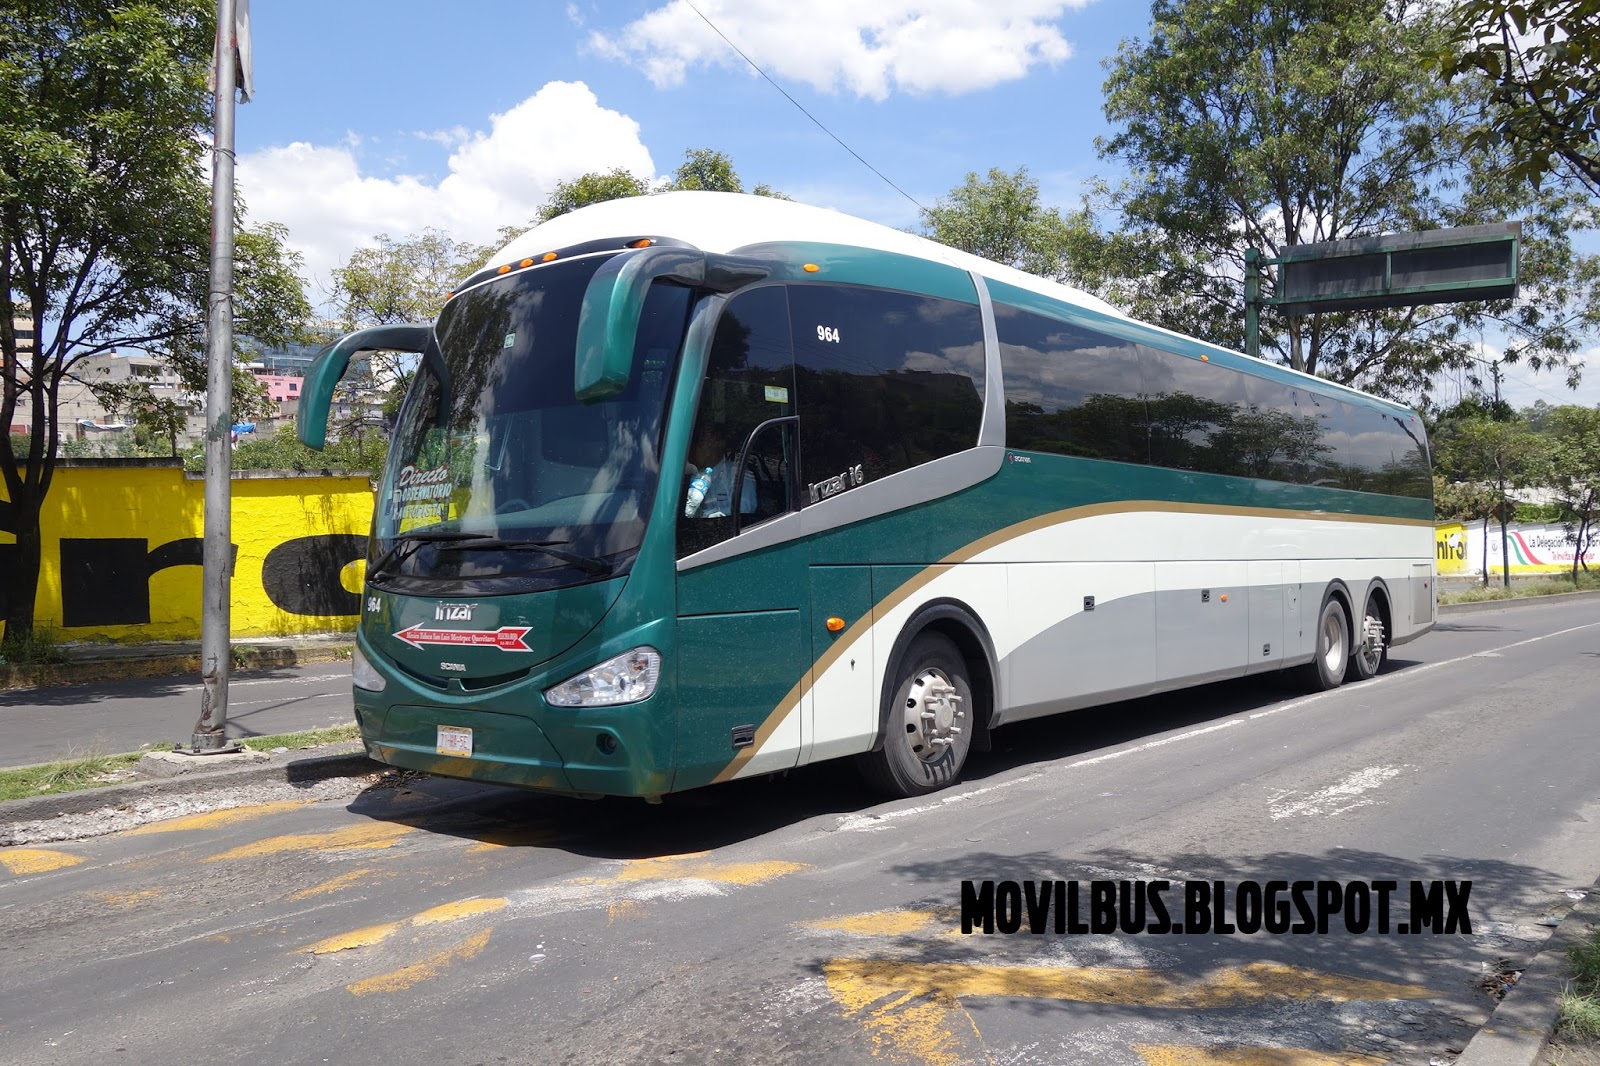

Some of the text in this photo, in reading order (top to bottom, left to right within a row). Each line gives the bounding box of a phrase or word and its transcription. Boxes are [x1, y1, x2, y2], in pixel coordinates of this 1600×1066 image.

[816, 325, 841, 344] 964
[400, 464, 448, 487] Directo
[849, 463, 864, 487] i6
[367, 596, 381, 613] 964
[440, 662, 467, 672] SCANIA
